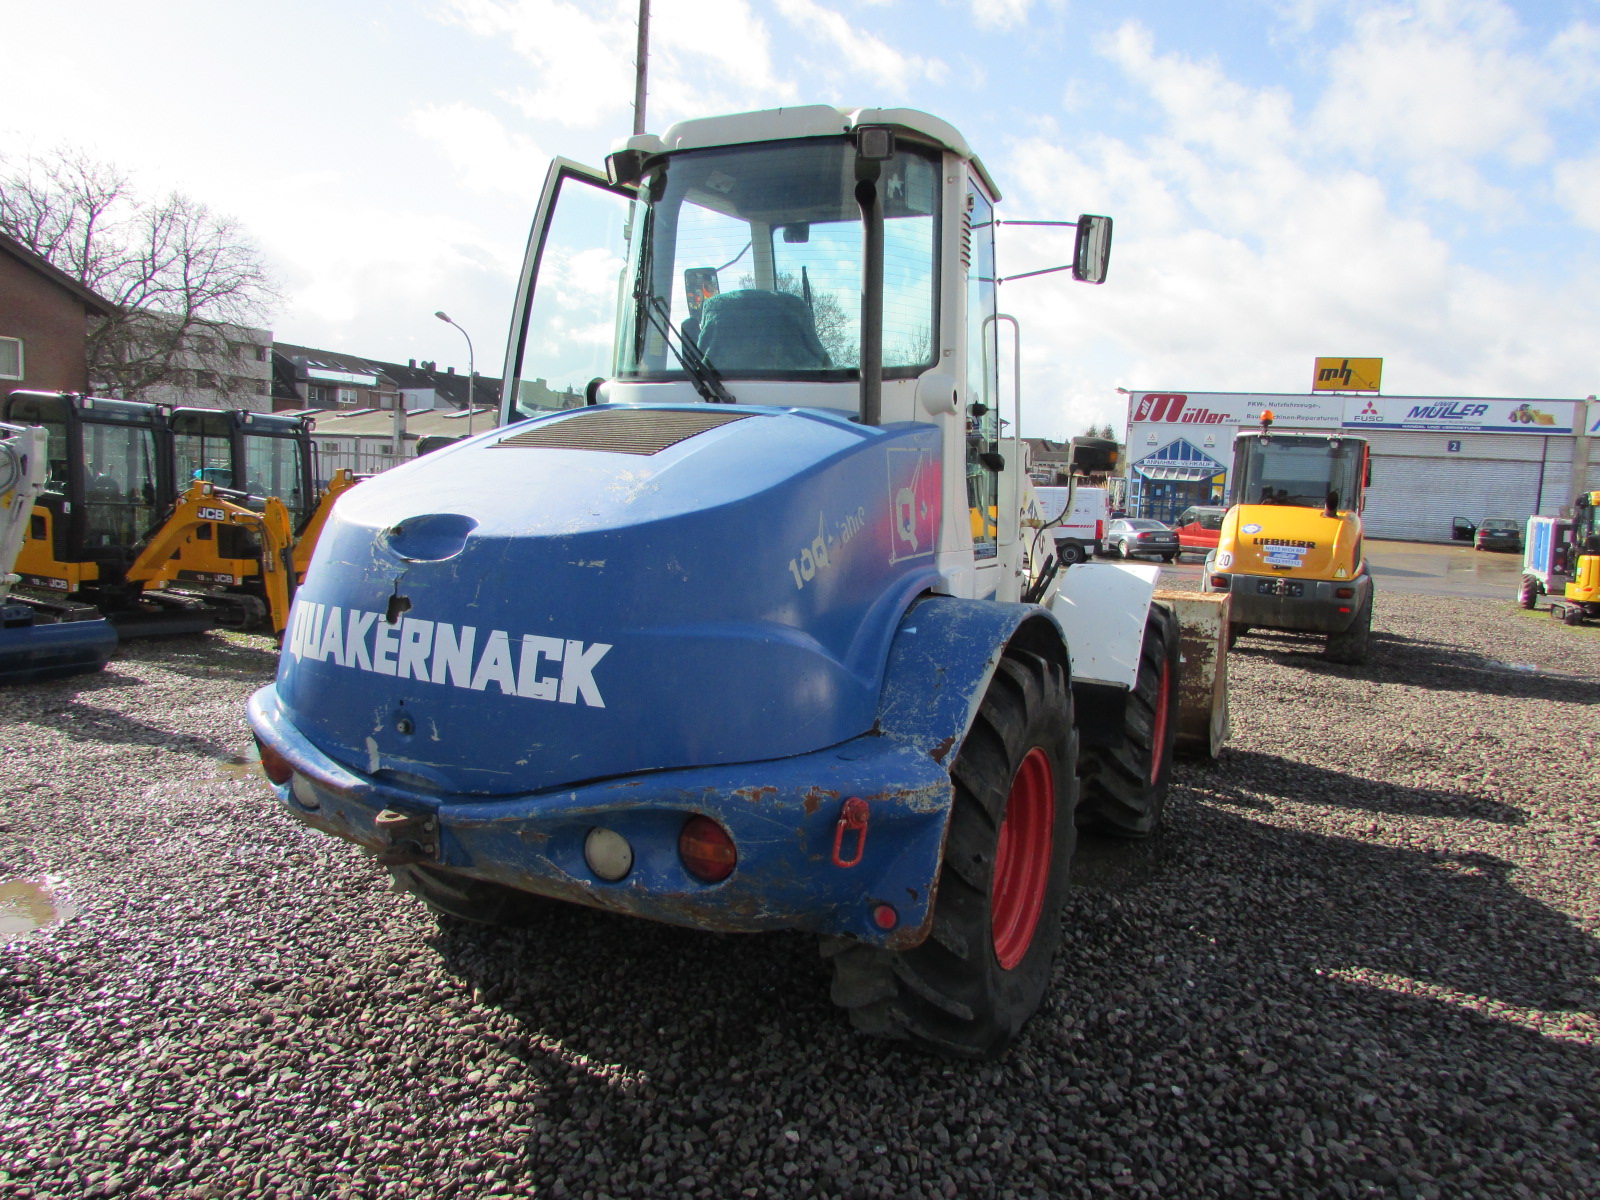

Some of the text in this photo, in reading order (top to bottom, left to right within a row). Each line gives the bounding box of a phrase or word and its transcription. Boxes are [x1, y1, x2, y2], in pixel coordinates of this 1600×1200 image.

[1133, 394, 1230, 424] Müller
[1407, 402, 1489, 419] MÜLLER
[1451, 442, 1458, 451] 2
[198, 507, 225, 521] JCB
[1253, 538, 1316, 549] LIEBHERR
[1218, 554, 1231, 567] 20
[49, 579, 68, 589] JCB
[214, 574, 233, 583] JCB
[290, 600, 613, 708] QUAKERNACK
